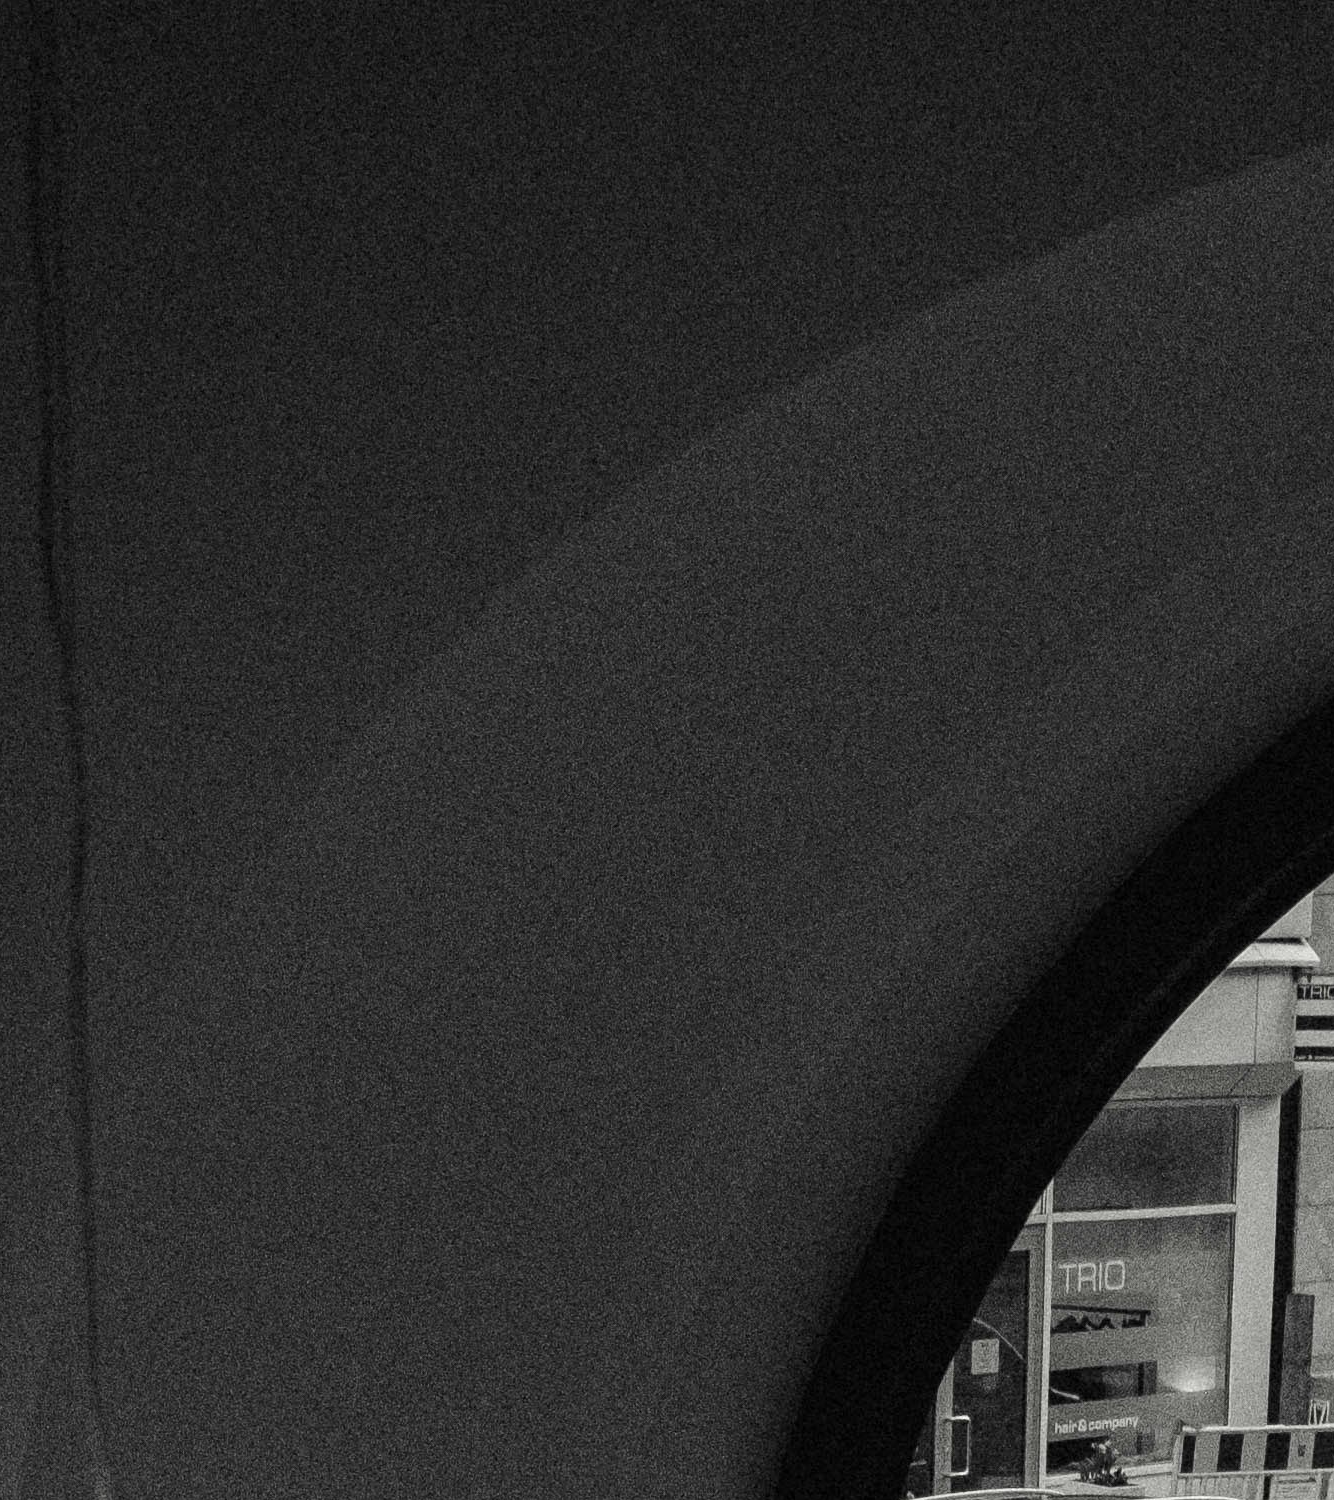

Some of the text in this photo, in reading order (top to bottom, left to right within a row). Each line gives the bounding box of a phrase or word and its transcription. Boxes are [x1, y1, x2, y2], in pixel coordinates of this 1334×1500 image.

[1057, 1260, 1126, 1294] TRIO
[1054, 1419, 1078, 1434] hair
[1088, 1416, 1139, 1431] company
